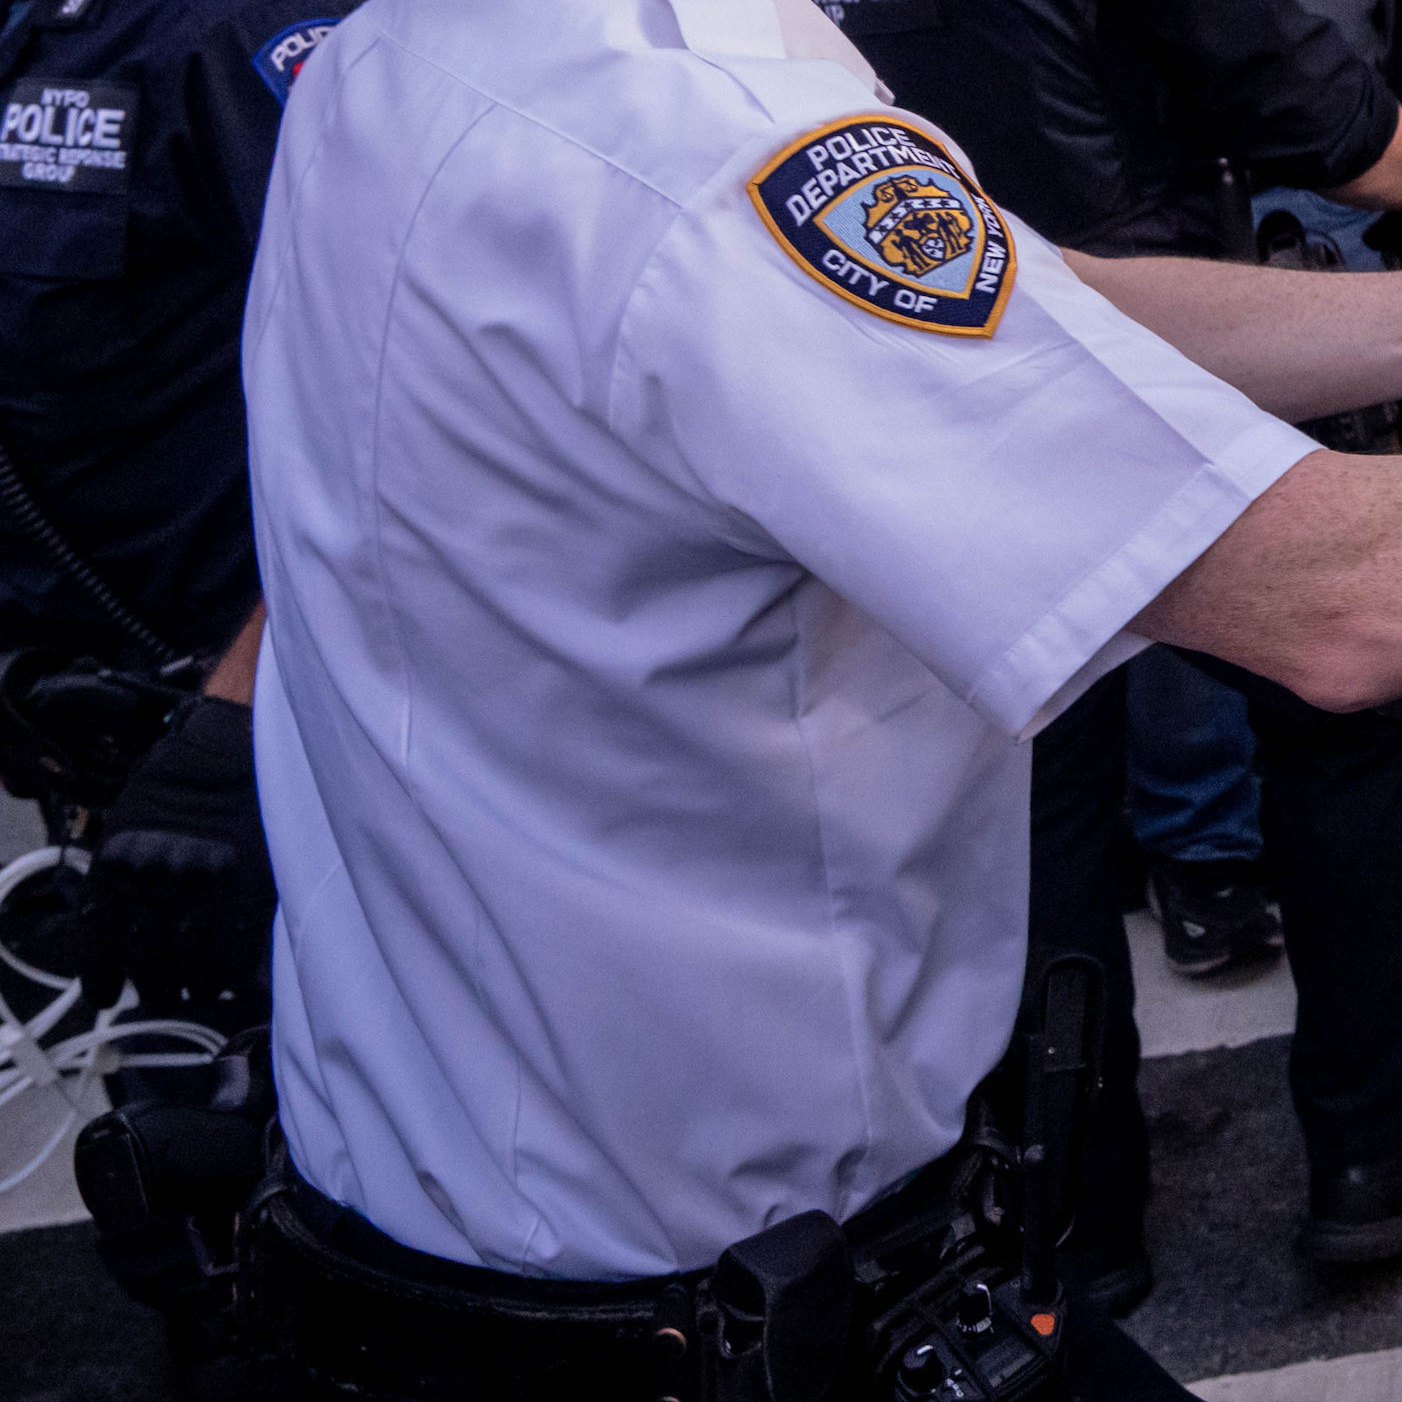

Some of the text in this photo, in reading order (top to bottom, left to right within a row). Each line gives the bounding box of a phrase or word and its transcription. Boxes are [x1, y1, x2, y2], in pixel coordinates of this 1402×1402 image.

[41, 87, 91, 108] NYPD
[0, 102, 127, 150] POLICE
[806, 126, 917, 172] POLICE
[784, 144, 963, 227] DEPARTMENT
[970, 191, 1008, 294] NEW YORK
[821, 249, 939, 313] CITY OF
